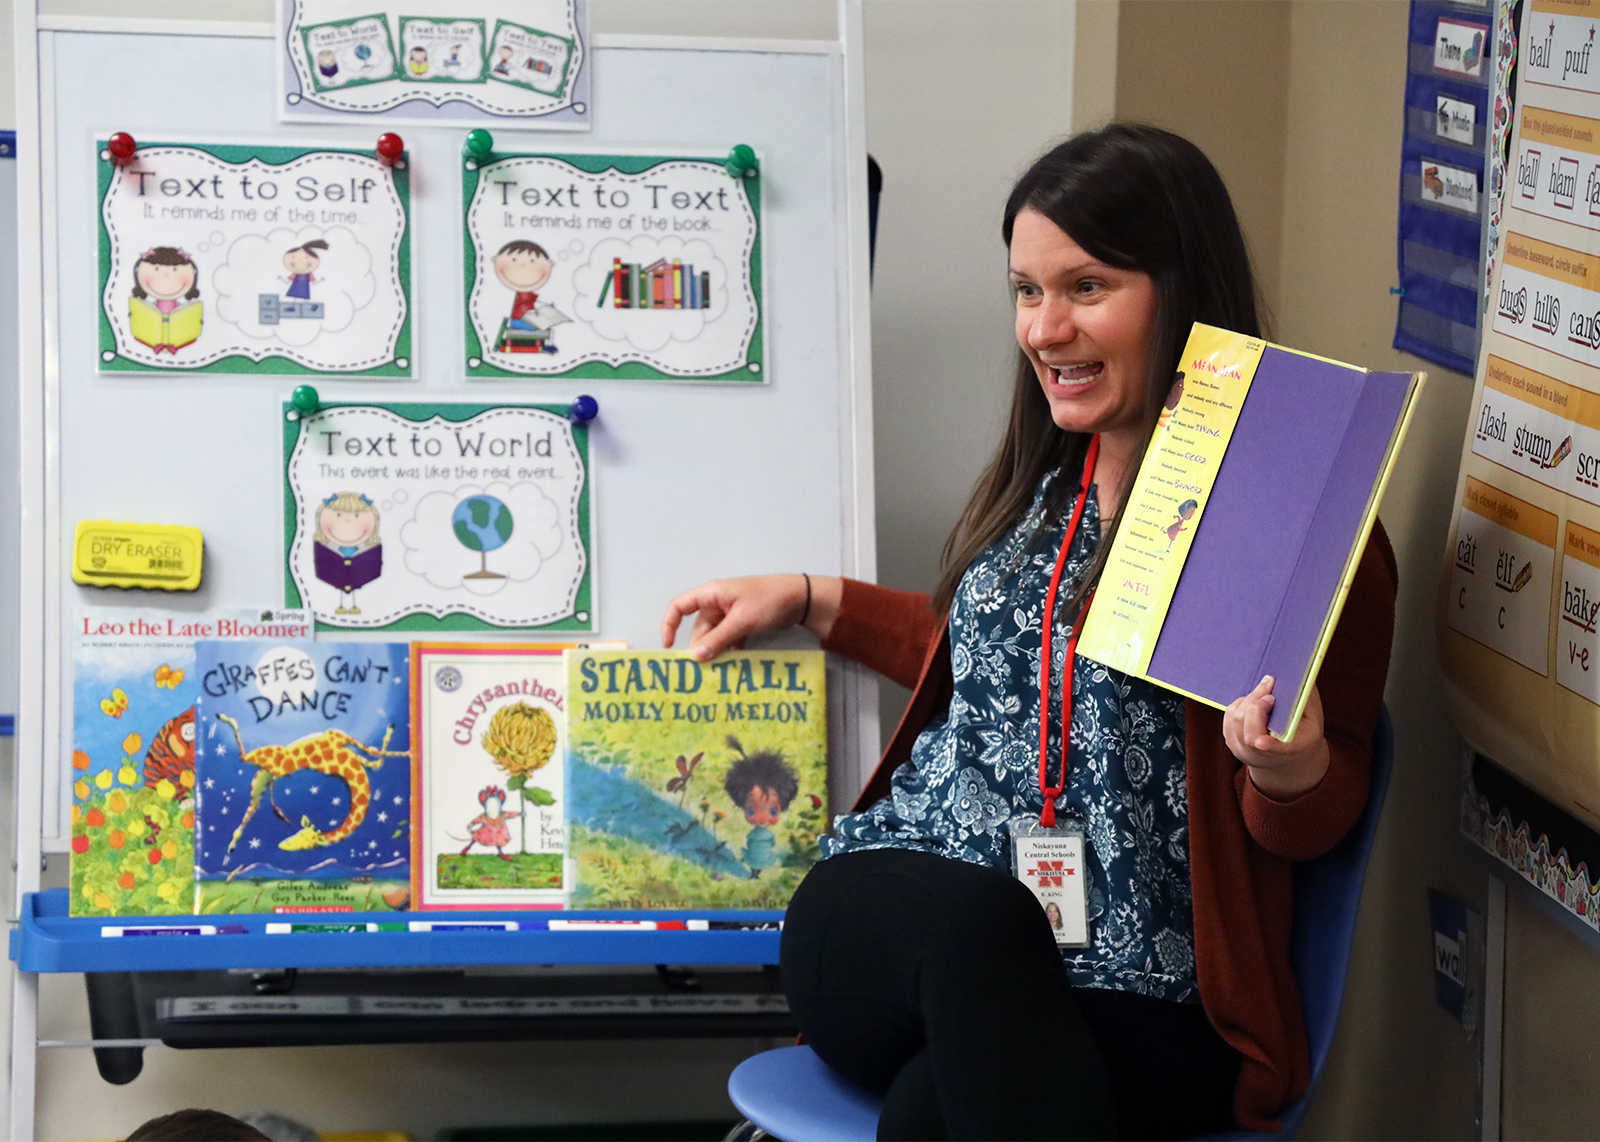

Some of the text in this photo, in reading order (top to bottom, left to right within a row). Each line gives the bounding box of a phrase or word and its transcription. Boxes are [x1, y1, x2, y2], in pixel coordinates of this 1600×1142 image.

[409, 25, 437, 34] Text
[452, 26, 475, 36] Self
[1529, 36, 1593, 80] ball puff
[129, 171, 377, 203] Text to Self
[1518, 155, 1538, 188] ball
[1548, 163, 1574, 198] ham
[494, 181, 729, 211] Text to Text
[143, 203, 155, 218] It
[161, 204, 225, 221] reminds
[231, 208, 257, 221] me
[264, 205, 281, 221] of
[288, 208, 315, 223] the
[504, 212, 514, 227] It
[520, 213, 582, 229] reminds
[587, 217, 612, 229] me
[618, 214, 636, 230] of
[641, 215, 668, 231] the
[1555, 256, 1571, 272] circle
[1499, 280, 1525, 324] bugs
[1533, 291, 1558, 328] hills
[1192, 358, 1218, 374] MEAN
[1512, 376, 1526, 391] each
[1526, 382, 1543, 397] sound
[320, 430, 552, 458] Text to World
[1478, 404, 1507, 442] flash
[1513, 423, 1552, 469] stump
[319, 463, 345, 479] This
[350, 465, 389, 479] event
[396, 467, 420, 479] was
[425, 465, 450, 480] like
[455, 464, 478, 480] the
[483, 465, 512, 480] real
[91, 542, 182, 558] DRY ERASER
[1568, 532, 1585, 551] Mark
[275, 611, 305, 622] Spring
[83, 617, 309, 638] Leo the Late Bloomer
[203, 655, 389, 698] GIRAFFES CAN'T
[580, 657, 813, 696] STAND TALL,
[248, 690, 352, 723] DANCE
[583, 701, 808, 723] MOLLY LOU MELON
[540, 810, 553, 826] by
[271, 892, 355, 904] Guy Parker-Rees
